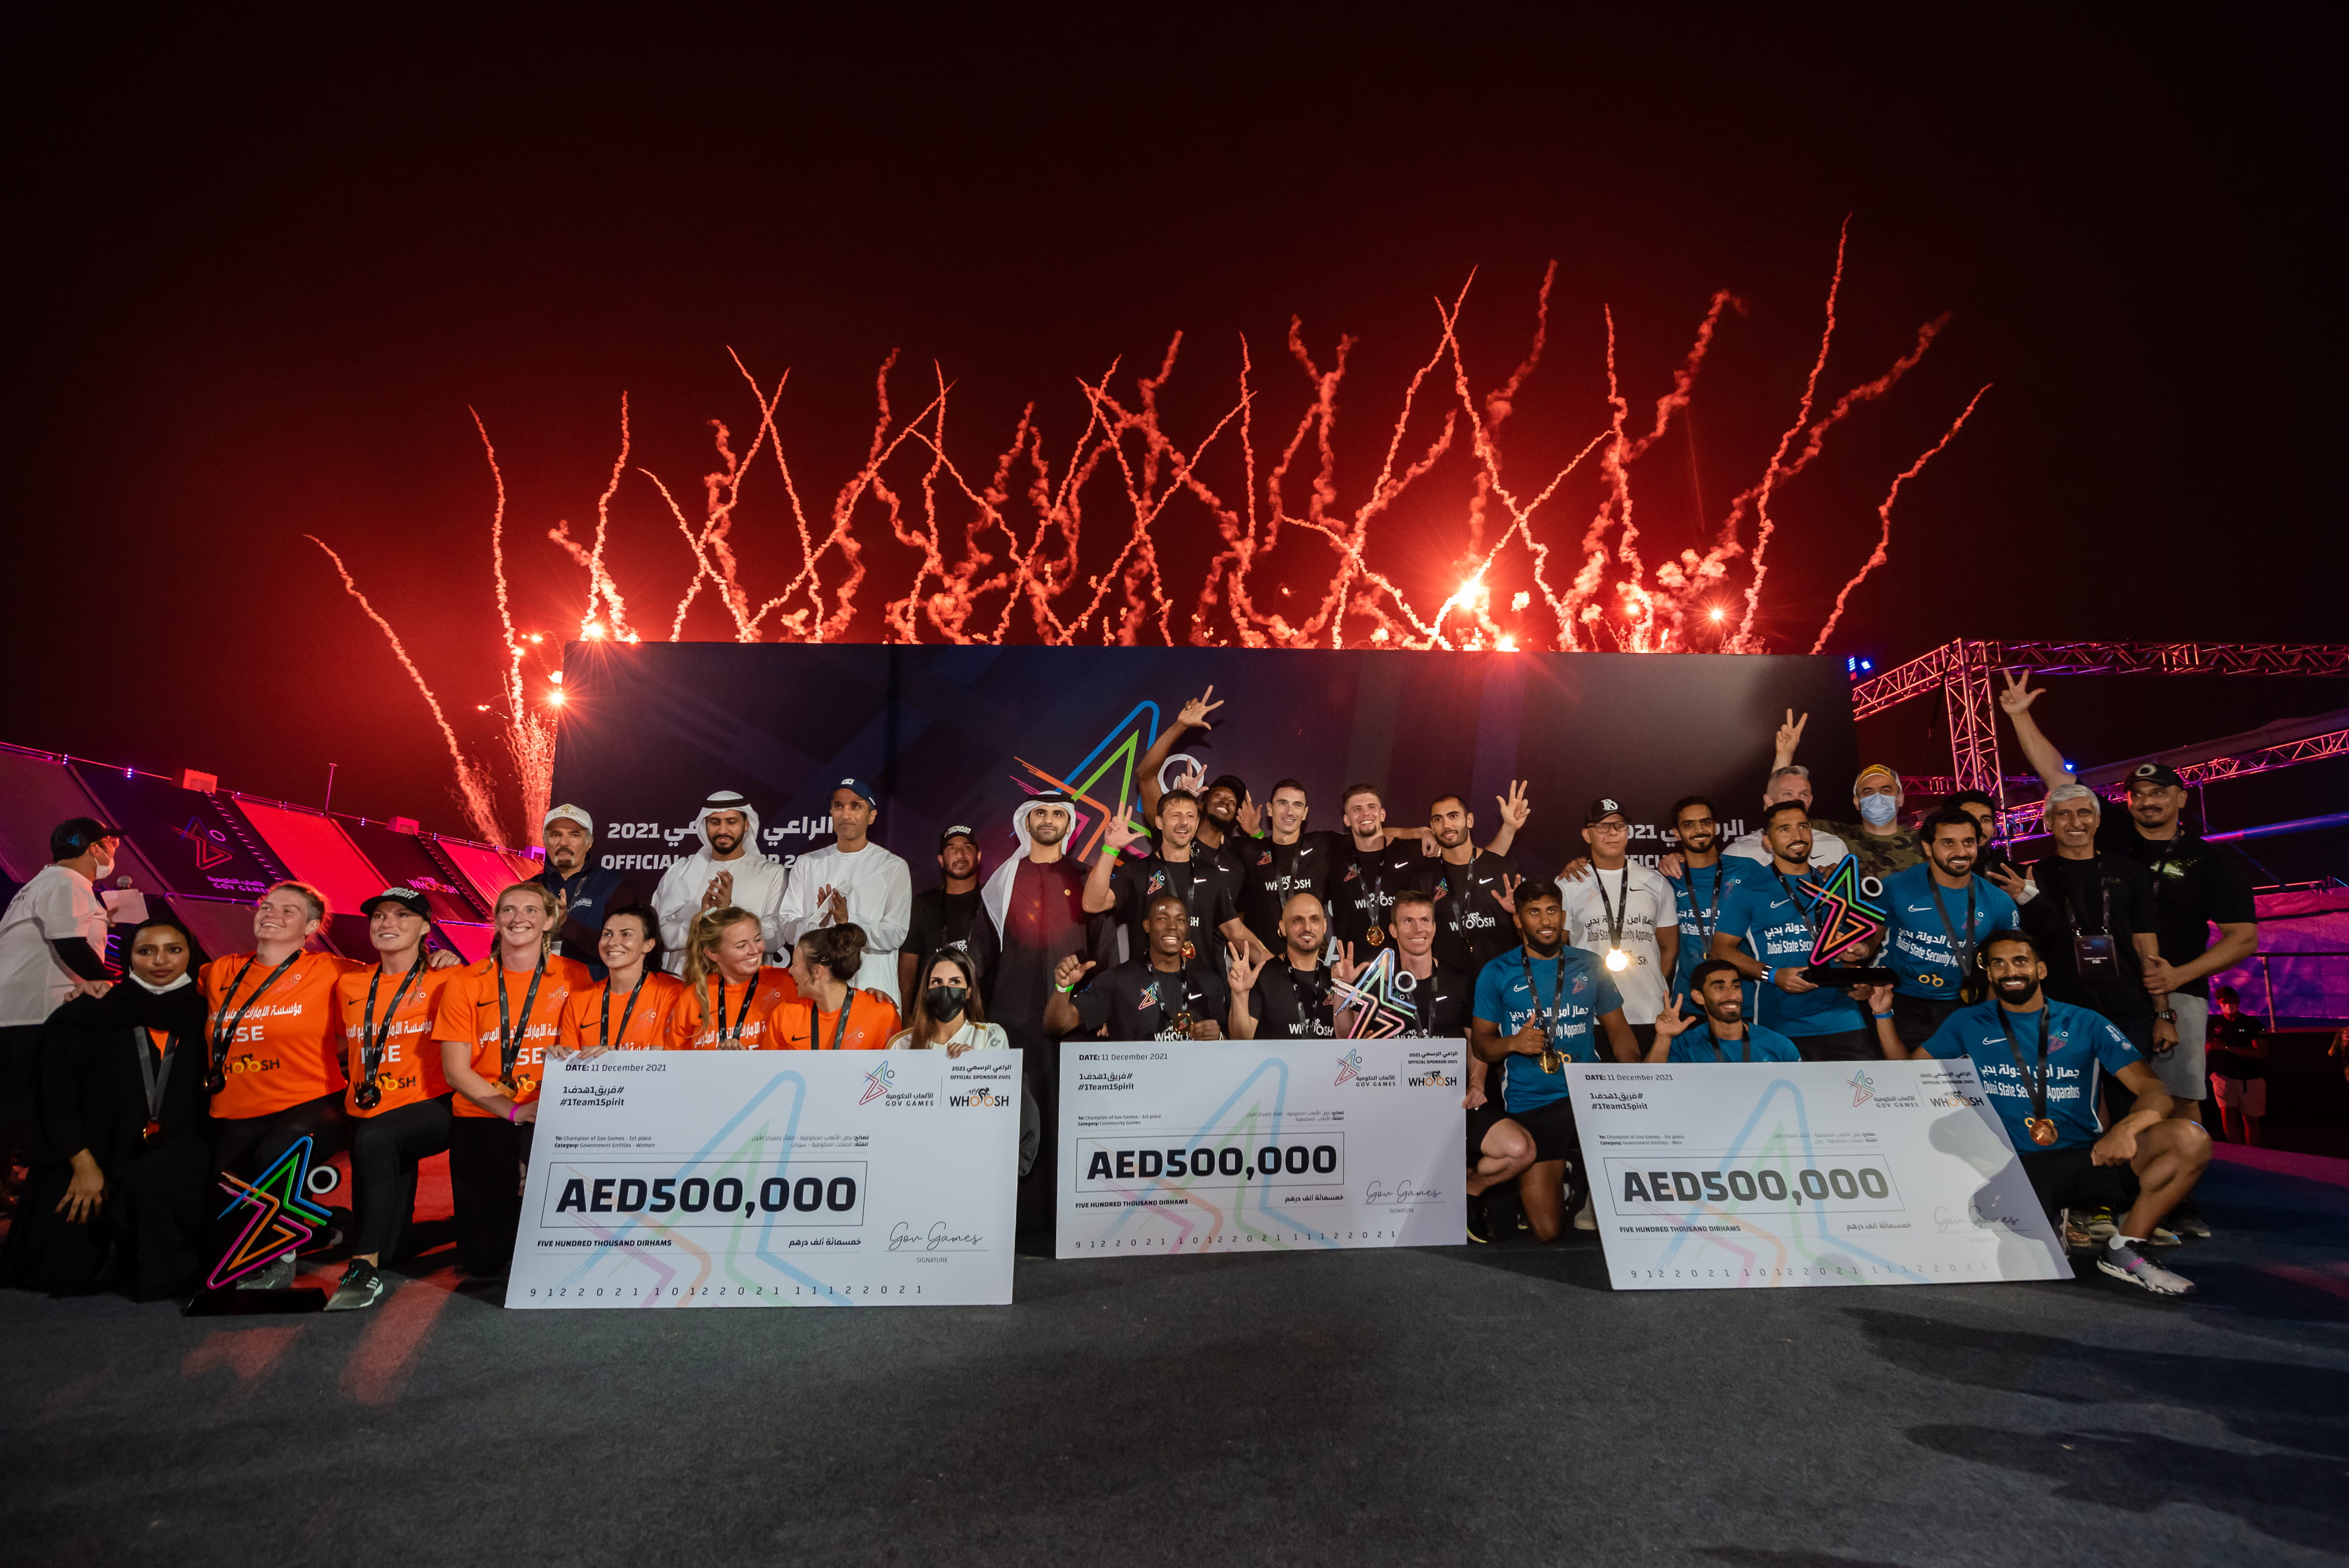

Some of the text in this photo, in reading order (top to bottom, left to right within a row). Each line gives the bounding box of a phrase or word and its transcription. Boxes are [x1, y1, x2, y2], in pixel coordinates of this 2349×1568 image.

[607, 823, 660, 839] 2021
[406, 879, 459, 894] WHOOSH
[1767, 940, 1799, 955] Dubai State
[1924, 948, 1951, 967] Security
[517, 1047, 544, 1066] SE
[224, 1058, 280, 1074] HOOSH
[1078, 1083, 1134, 1091] #1Team1Spirit
[1408, 1076, 1457, 1086] WHOOSH
[1998, 1082, 2016, 1097] State
[2047, 1085, 2080, 1102] Apparatus
[560, 1098, 624, 1107] #1Team1Spirit
[950, 1095, 1009, 1107] WHOOSH
[1930, 1096, 1984, 1108] WHOOSH
[1086, 1145, 1337, 1182] AED500,000
[1624, 1167, 1889, 1206] AED500,000
[556, 1177, 856, 1219] AED500,000
[789, 1239, 808, 1248] درهم
[826, 1237, 861, 1246] خمسمائة
[889, 1222, 983, 1250] Gov Games
